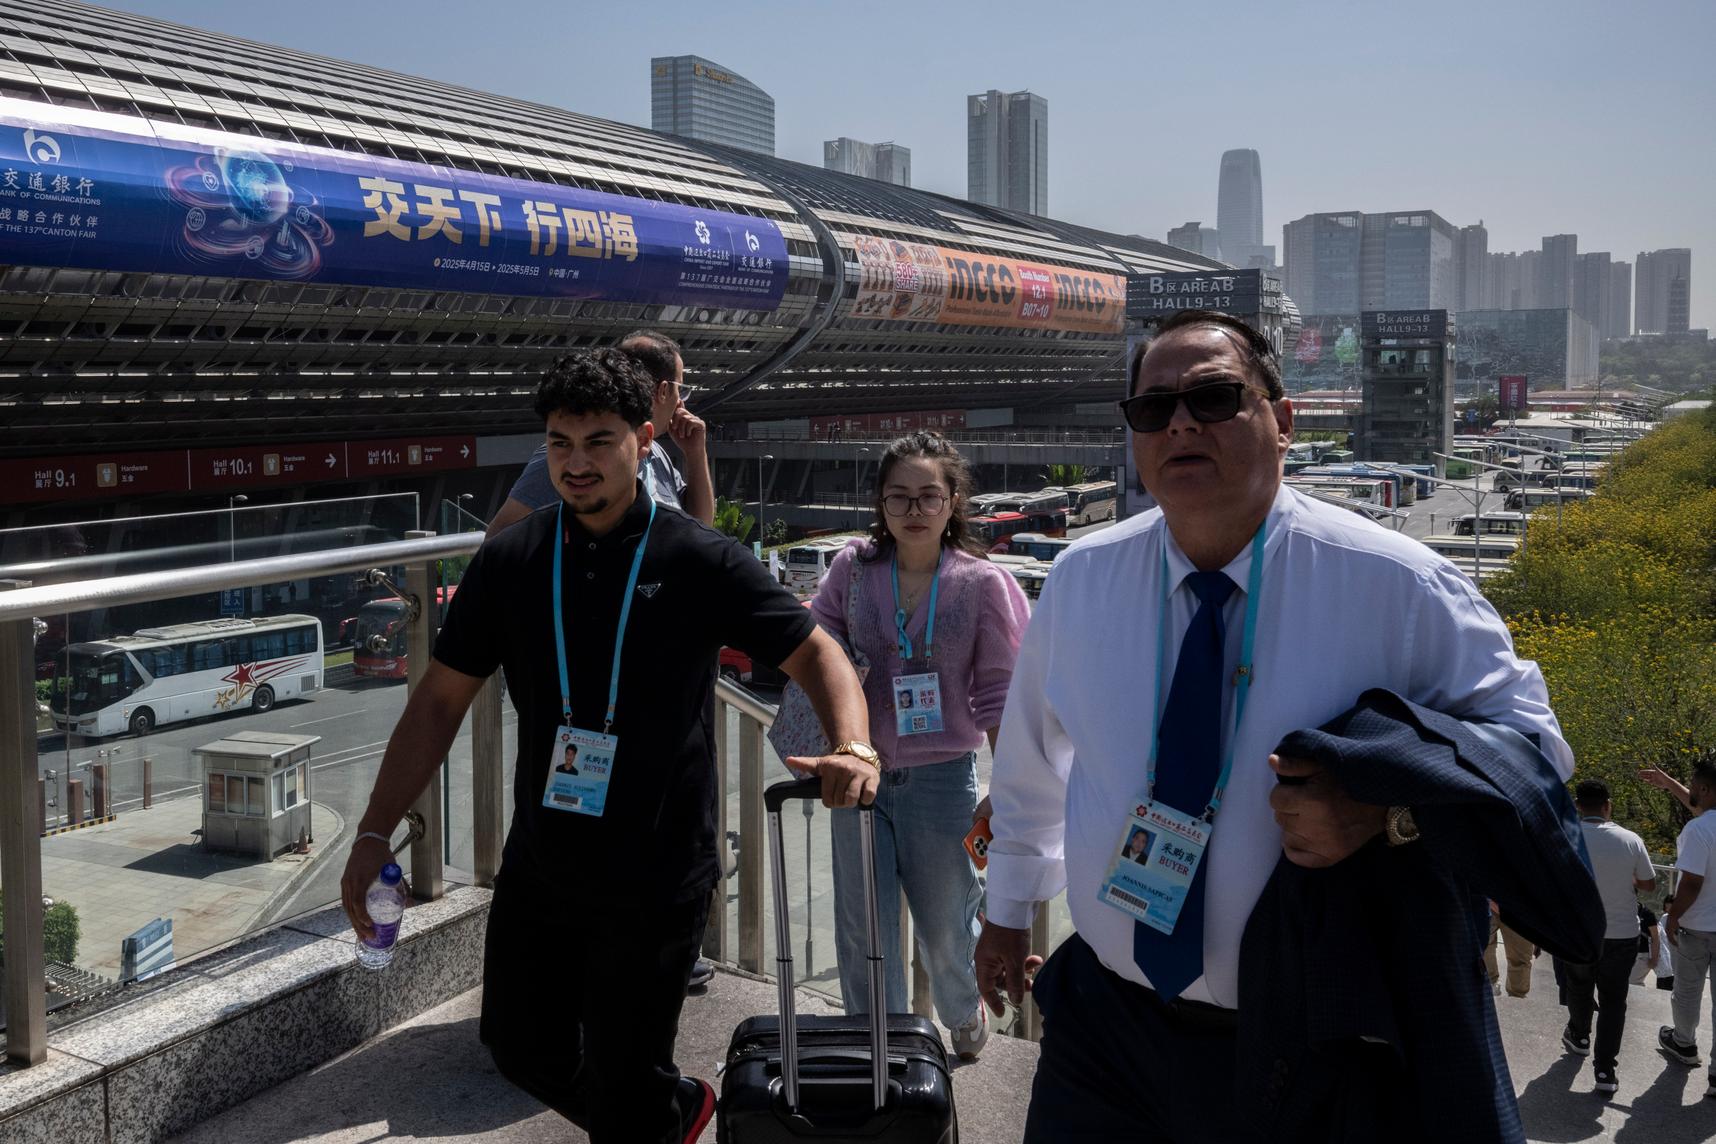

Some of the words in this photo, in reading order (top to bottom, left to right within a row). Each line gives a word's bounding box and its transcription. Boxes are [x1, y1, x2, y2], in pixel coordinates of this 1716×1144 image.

[0, 190, 16, 198] ANK
[20, 191, 31, 199] OF
[34, 193, 101, 206] COMMUNICATIONS
[358, 176, 502, 248] 交天下
[522, 199, 639, 263] 行四海
[6, 224, 22, 233] THE
[42, 227, 77, 237] CANTON
[79, 231, 97, 239] FAIR
[441, 258, 490, 272] 2025年4月15日
[497, 263, 540, 276] 2025年5月5日
[1180, 281, 1220, 293] AREA
[1223, 279, 1234, 292] B
[1423, 314, 1431, 323] B
[381, 449, 400, 464] 11.1
[213, 459, 227, 468] Hall
[230, 458, 253, 475] 10.1
[35, 470, 52, 479] Hall
[55, 469, 75, 488] 9.1
[1161, 842, 1197, 865] 采购商
[1158, 855, 1190, 876] BUYER
